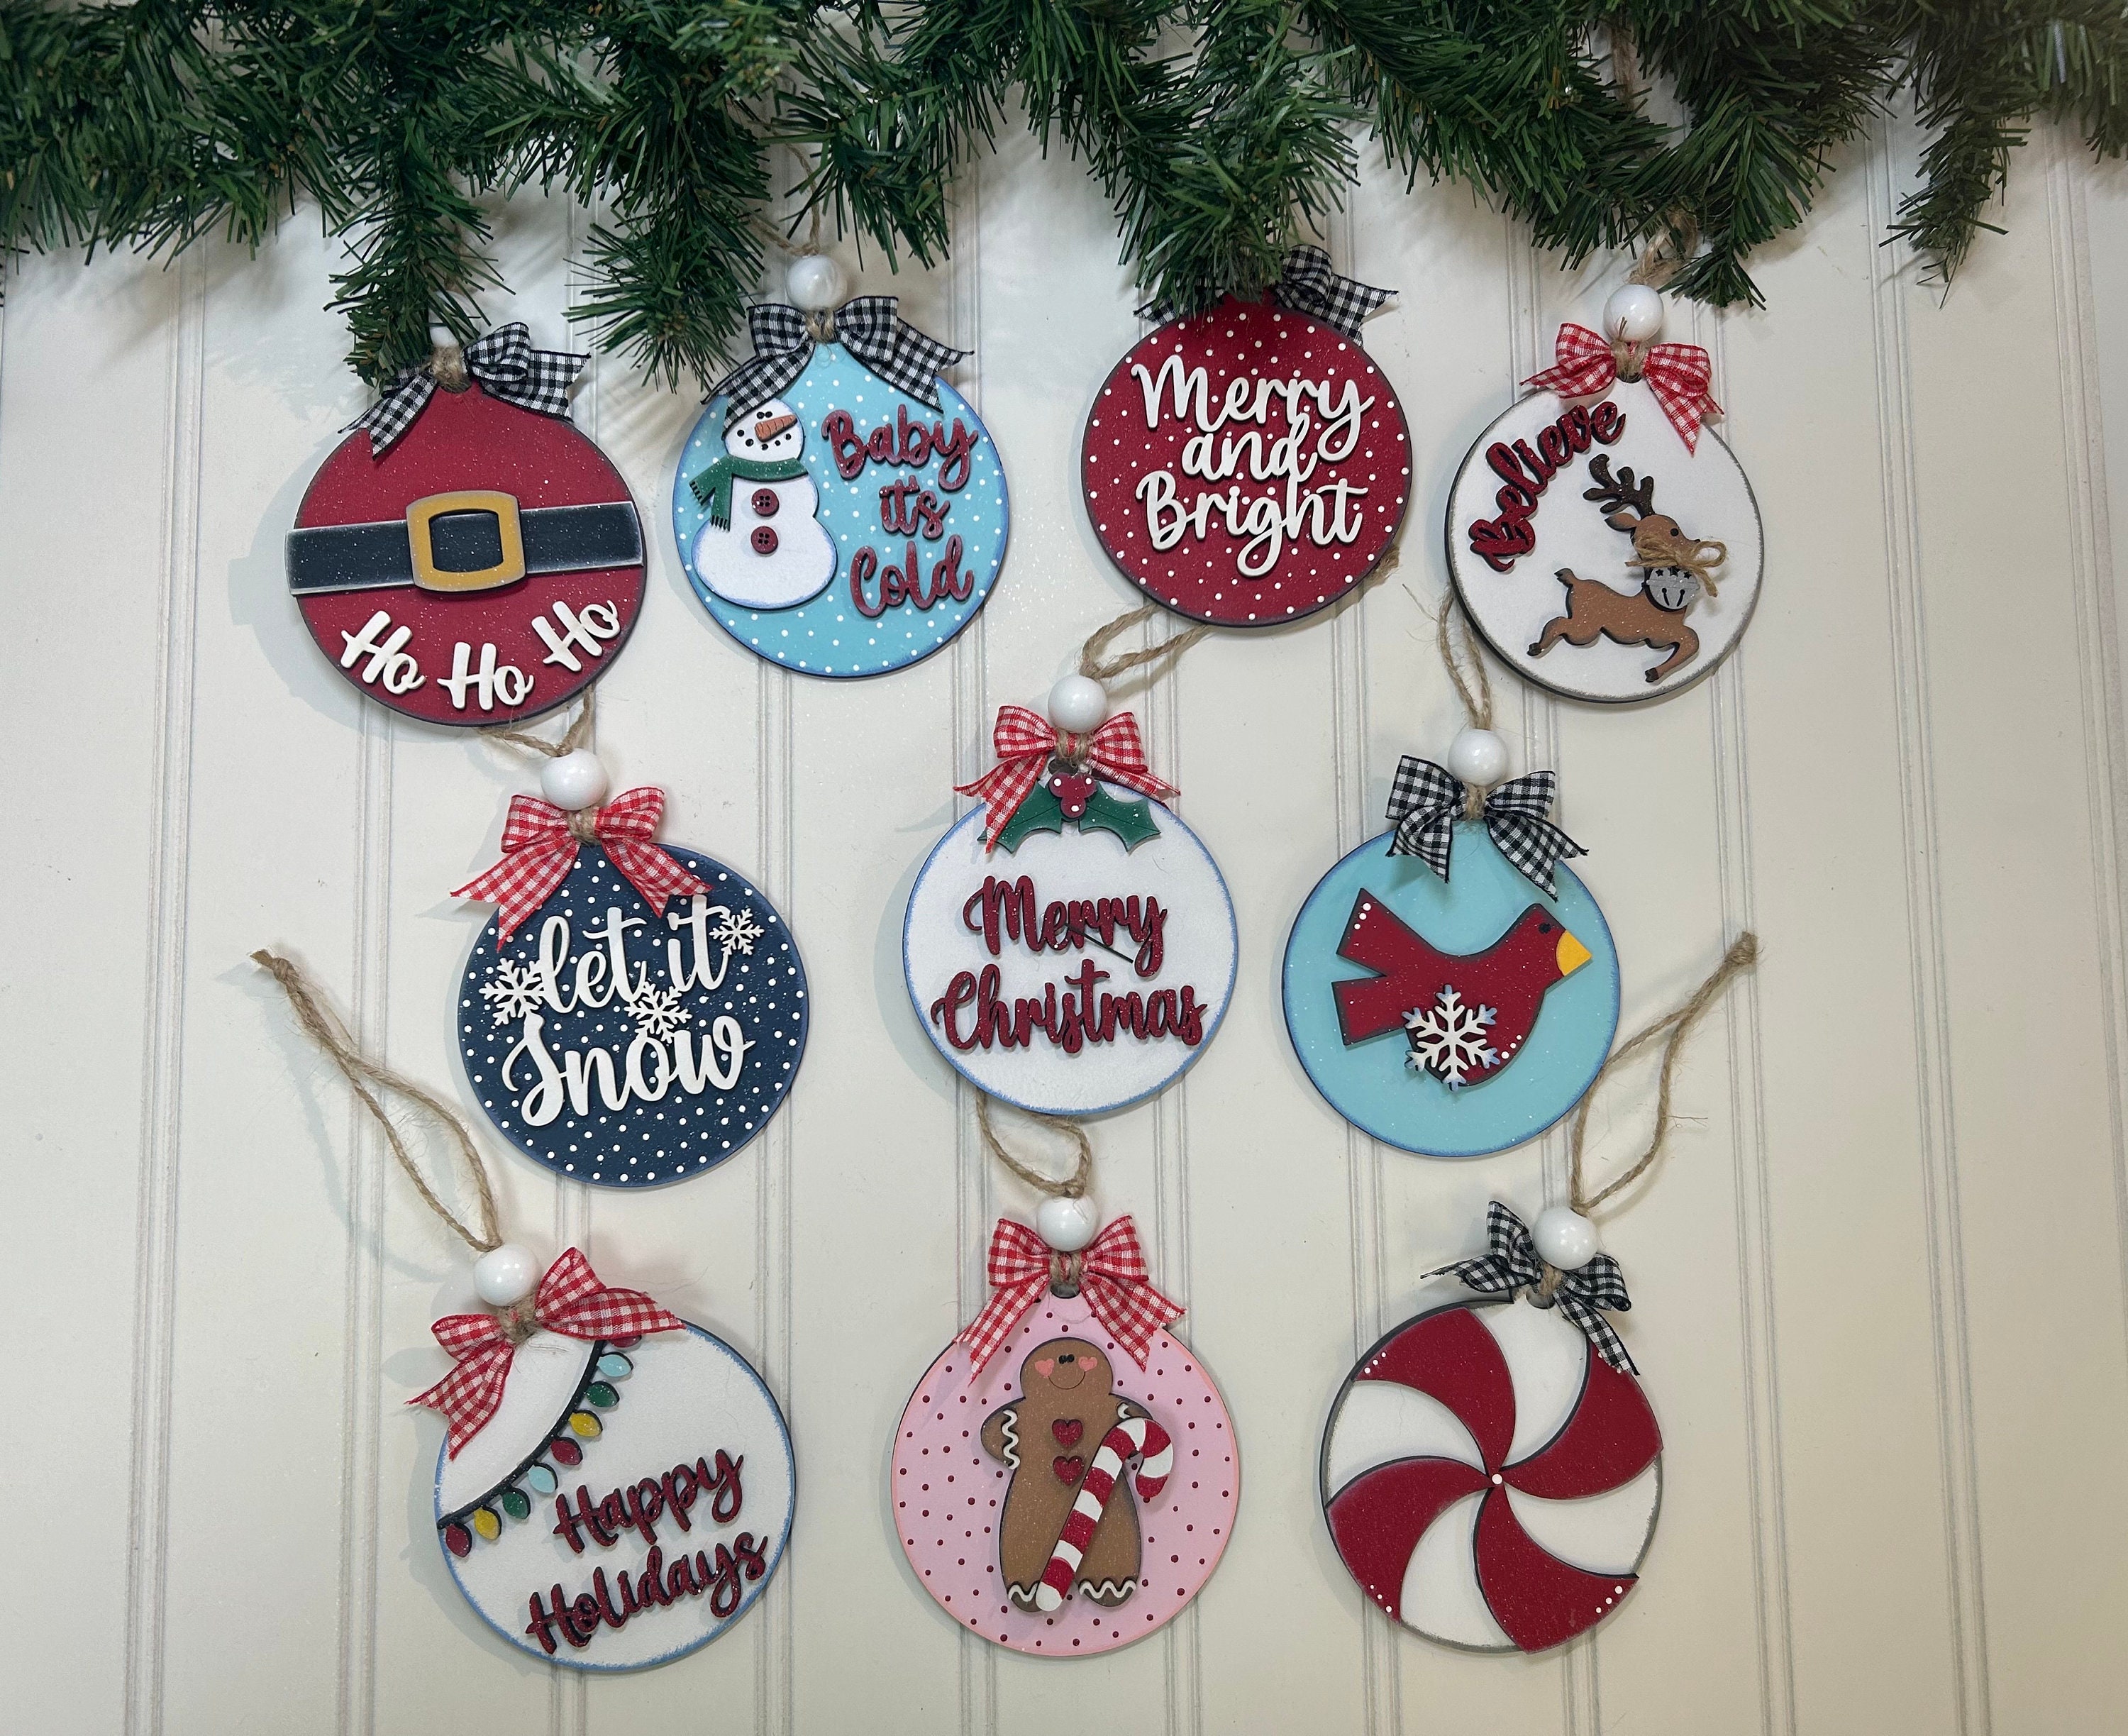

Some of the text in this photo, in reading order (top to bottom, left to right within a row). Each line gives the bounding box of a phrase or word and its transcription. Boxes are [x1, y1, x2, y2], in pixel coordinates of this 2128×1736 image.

[820, 402, 977, 492] Baby
[1130, 353, 1375, 462] Merry
[1180, 411, 1319, 483] and
[1136, 470, 1368, 578] Bright
[1468, 401, 1626, 572] Believe
[850, 533, 973, 618] Cold
[340, 599, 621, 710] Ho Ho Ho
[667, 894, 728, 992] it
[963, 875, 1167, 977] Merry
[930, 958, 1207, 1054] Christmas
[501, 1012, 756, 1127] Snow
[553, 1449, 744, 1554] Happy
[525, 1532, 768, 1654] Holidays
